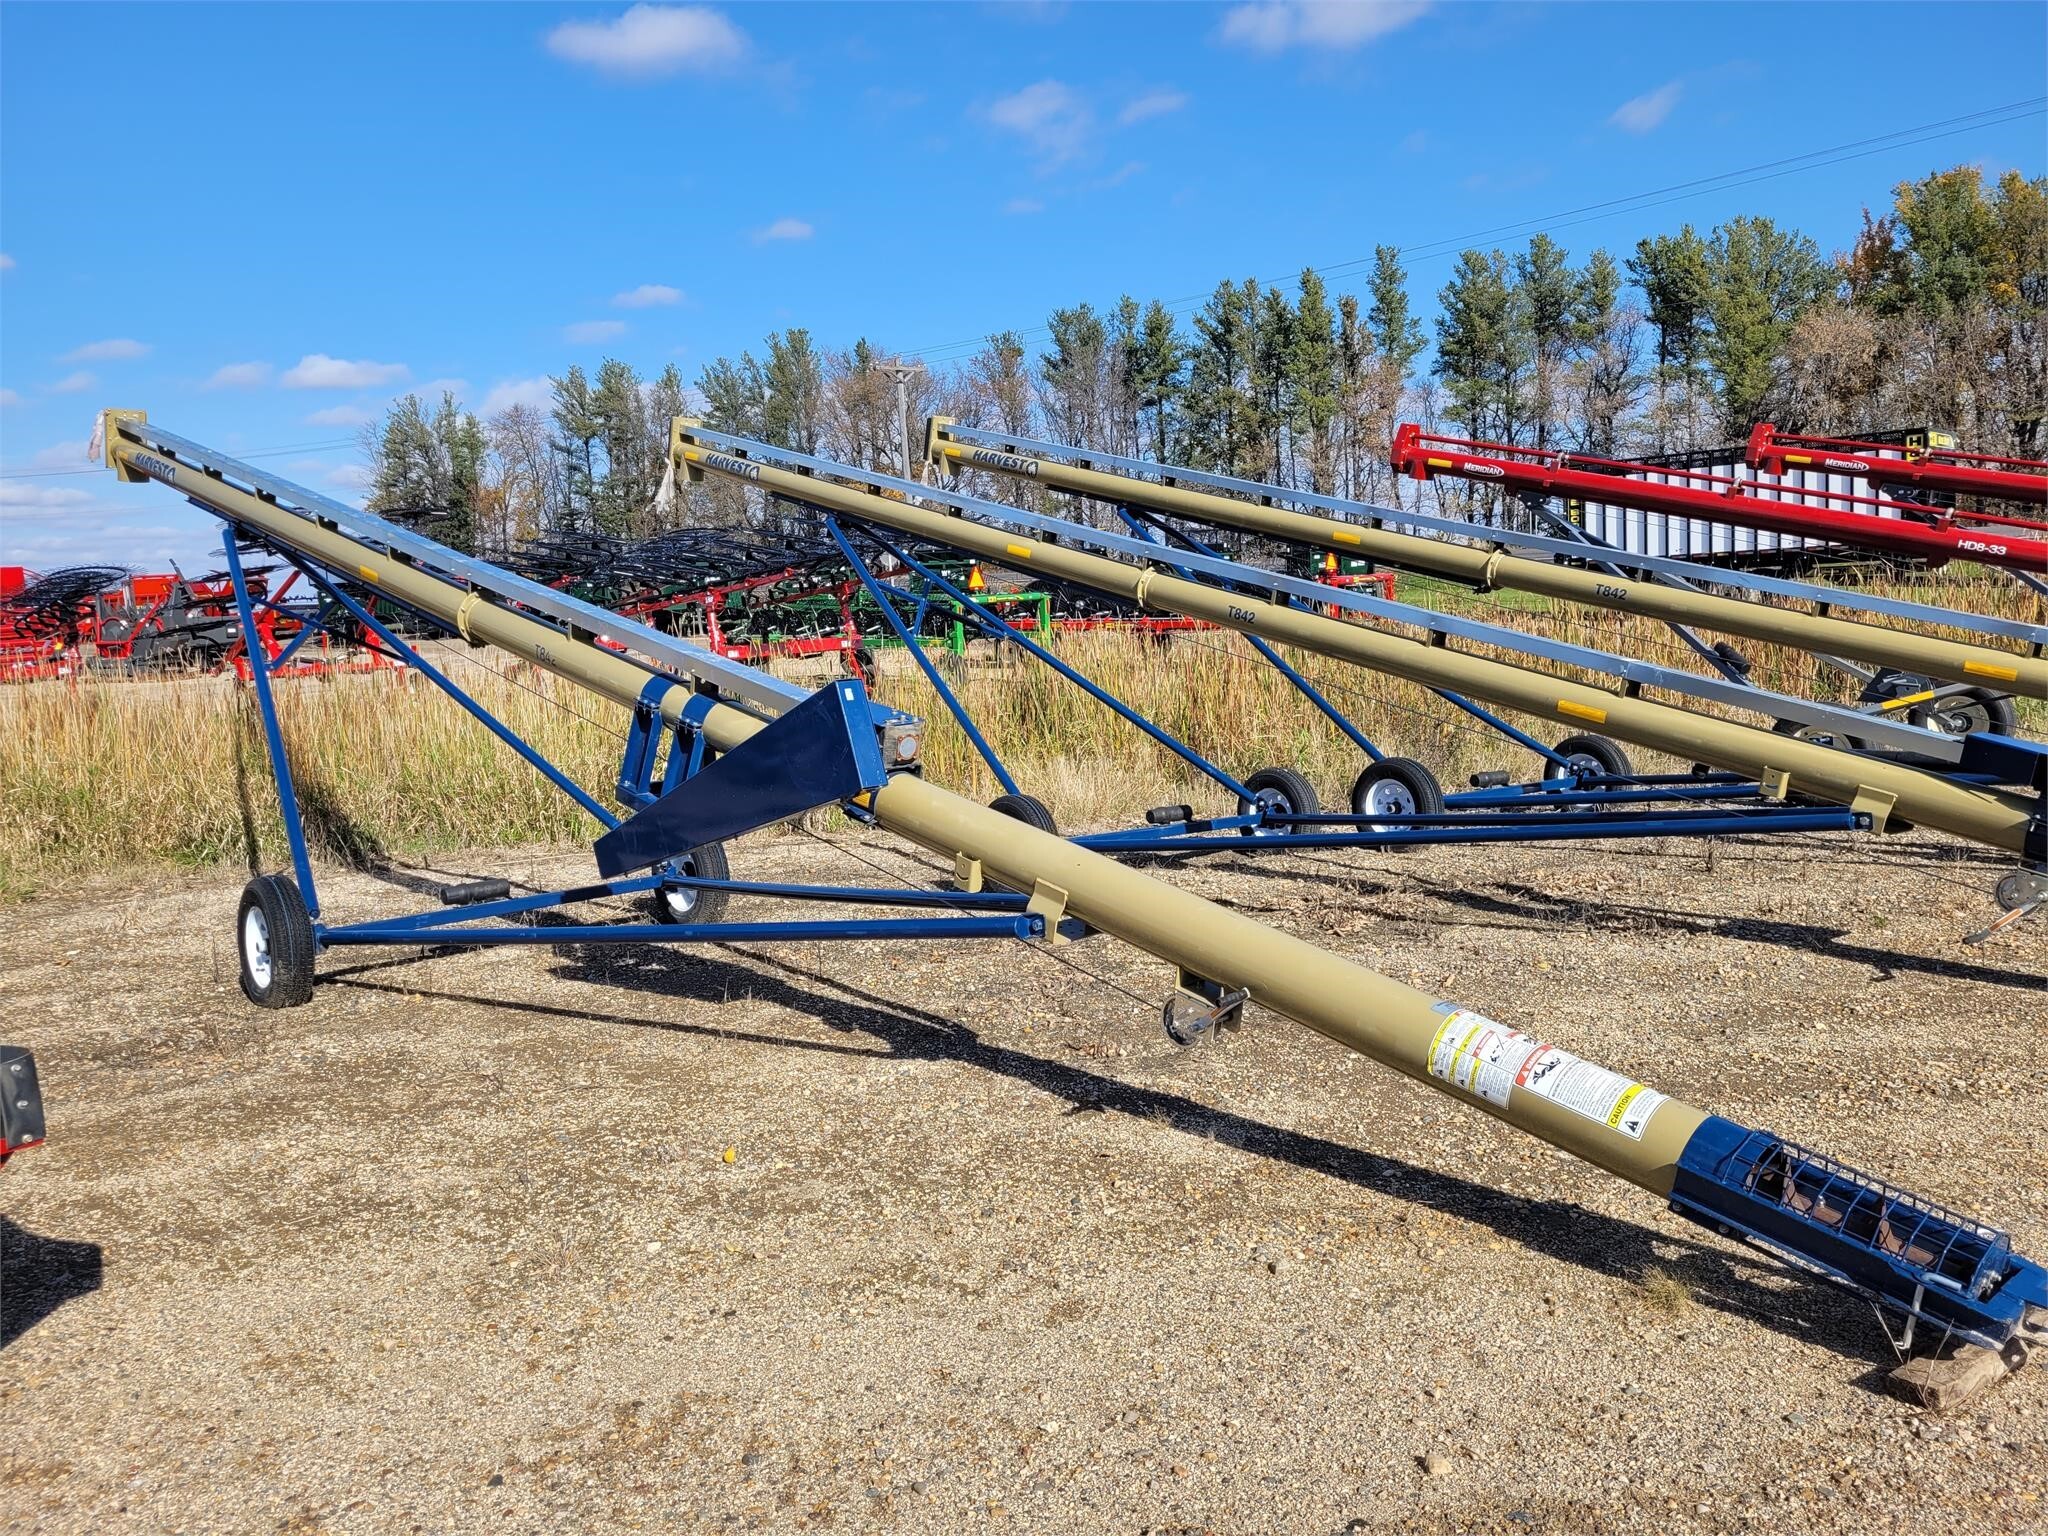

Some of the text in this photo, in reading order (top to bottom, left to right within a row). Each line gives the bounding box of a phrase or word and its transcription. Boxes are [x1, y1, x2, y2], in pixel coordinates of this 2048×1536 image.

[135, 452, 169, 479] HARVEST
[706, 453, 752, 479] HARVEST
[973, 449, 1027, 470] HARVEST
[1464, 462, 1500, 475] MERIDIAN
[1825, 458, 1864, 470] MERIDIAN
[1957, 539, 2007, 556] HD8-33
[1594, 583, 1628, 601] T842
[1228, 604, 1256, 625] T842
[1610, 1094, 1632, 1125] CAUTION
